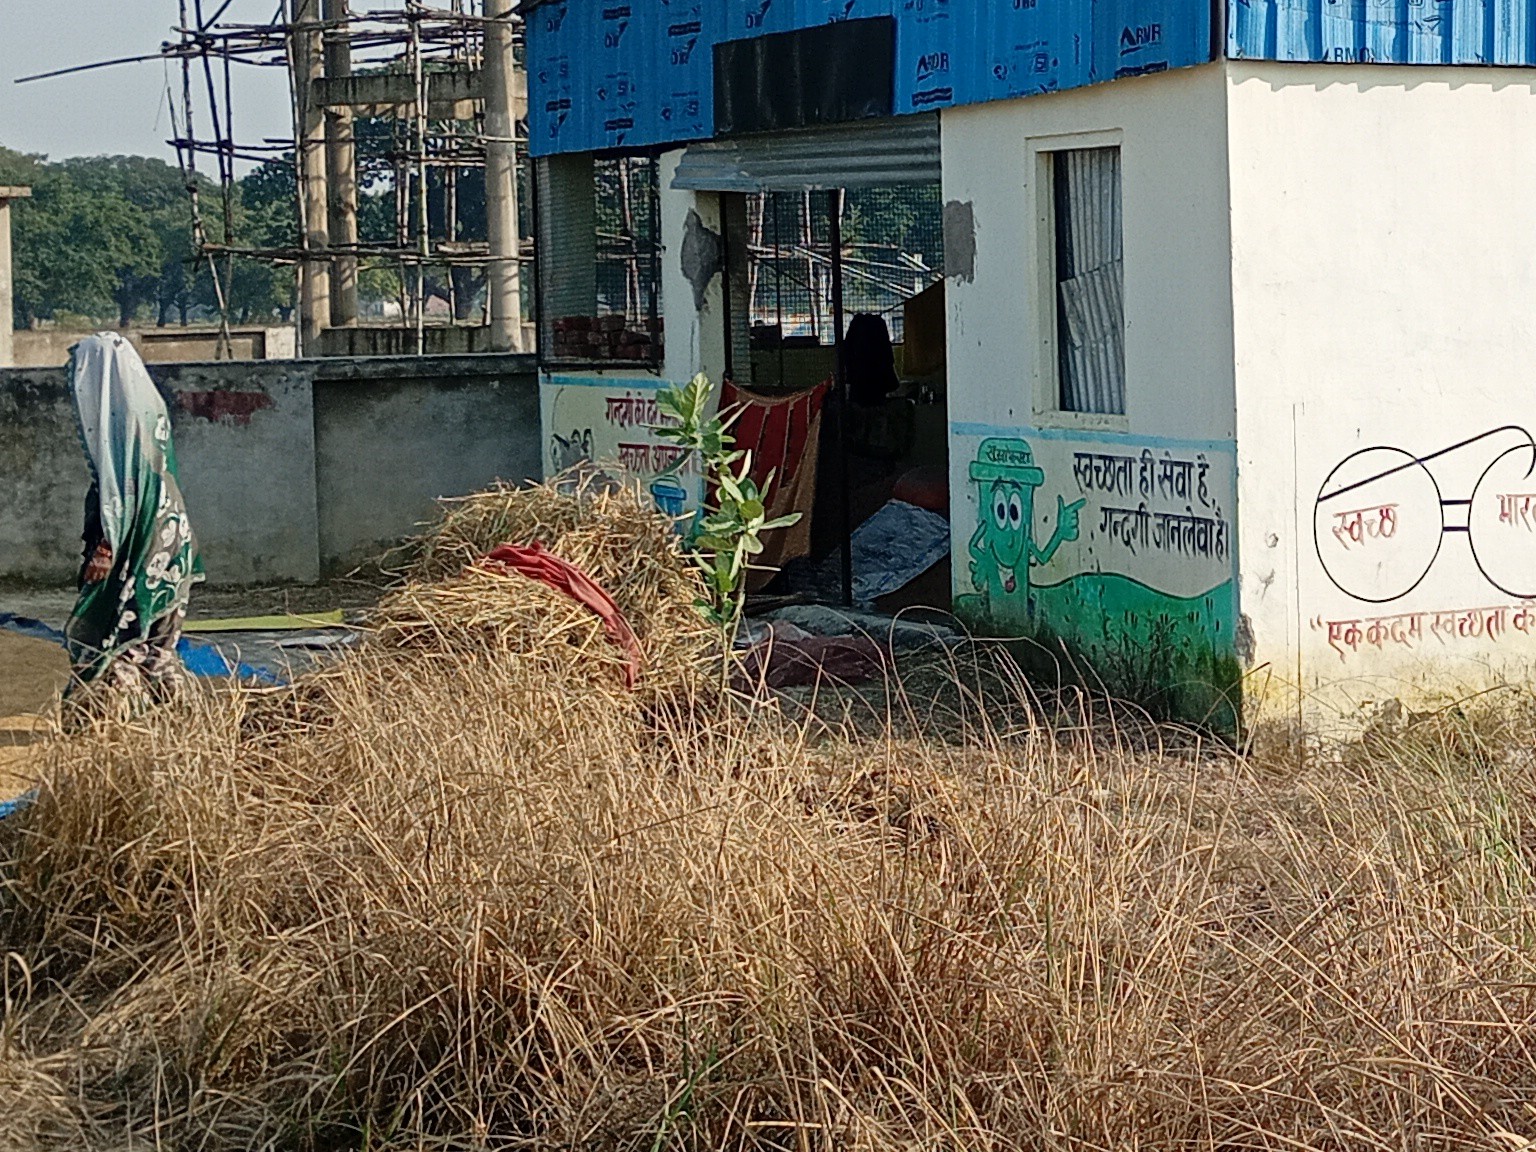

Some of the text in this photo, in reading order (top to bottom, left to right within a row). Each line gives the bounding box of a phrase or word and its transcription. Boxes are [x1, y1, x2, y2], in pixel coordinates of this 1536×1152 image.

[1072, 451, 1138, 497] स्वच्छता
[1138, 448, 1157, 499] ही
[1157, 450, 1195, 501] सेवा
[1099, 501, 1152, 557] गन्दगी
[1151, 505, 1216, 560] जानलेवा
[1331, 502, 1400, 551] स्वच्छ
[1364, 612, 1428, 650] कदम
[1429, 605, 1511, 646] स्वच्छता
